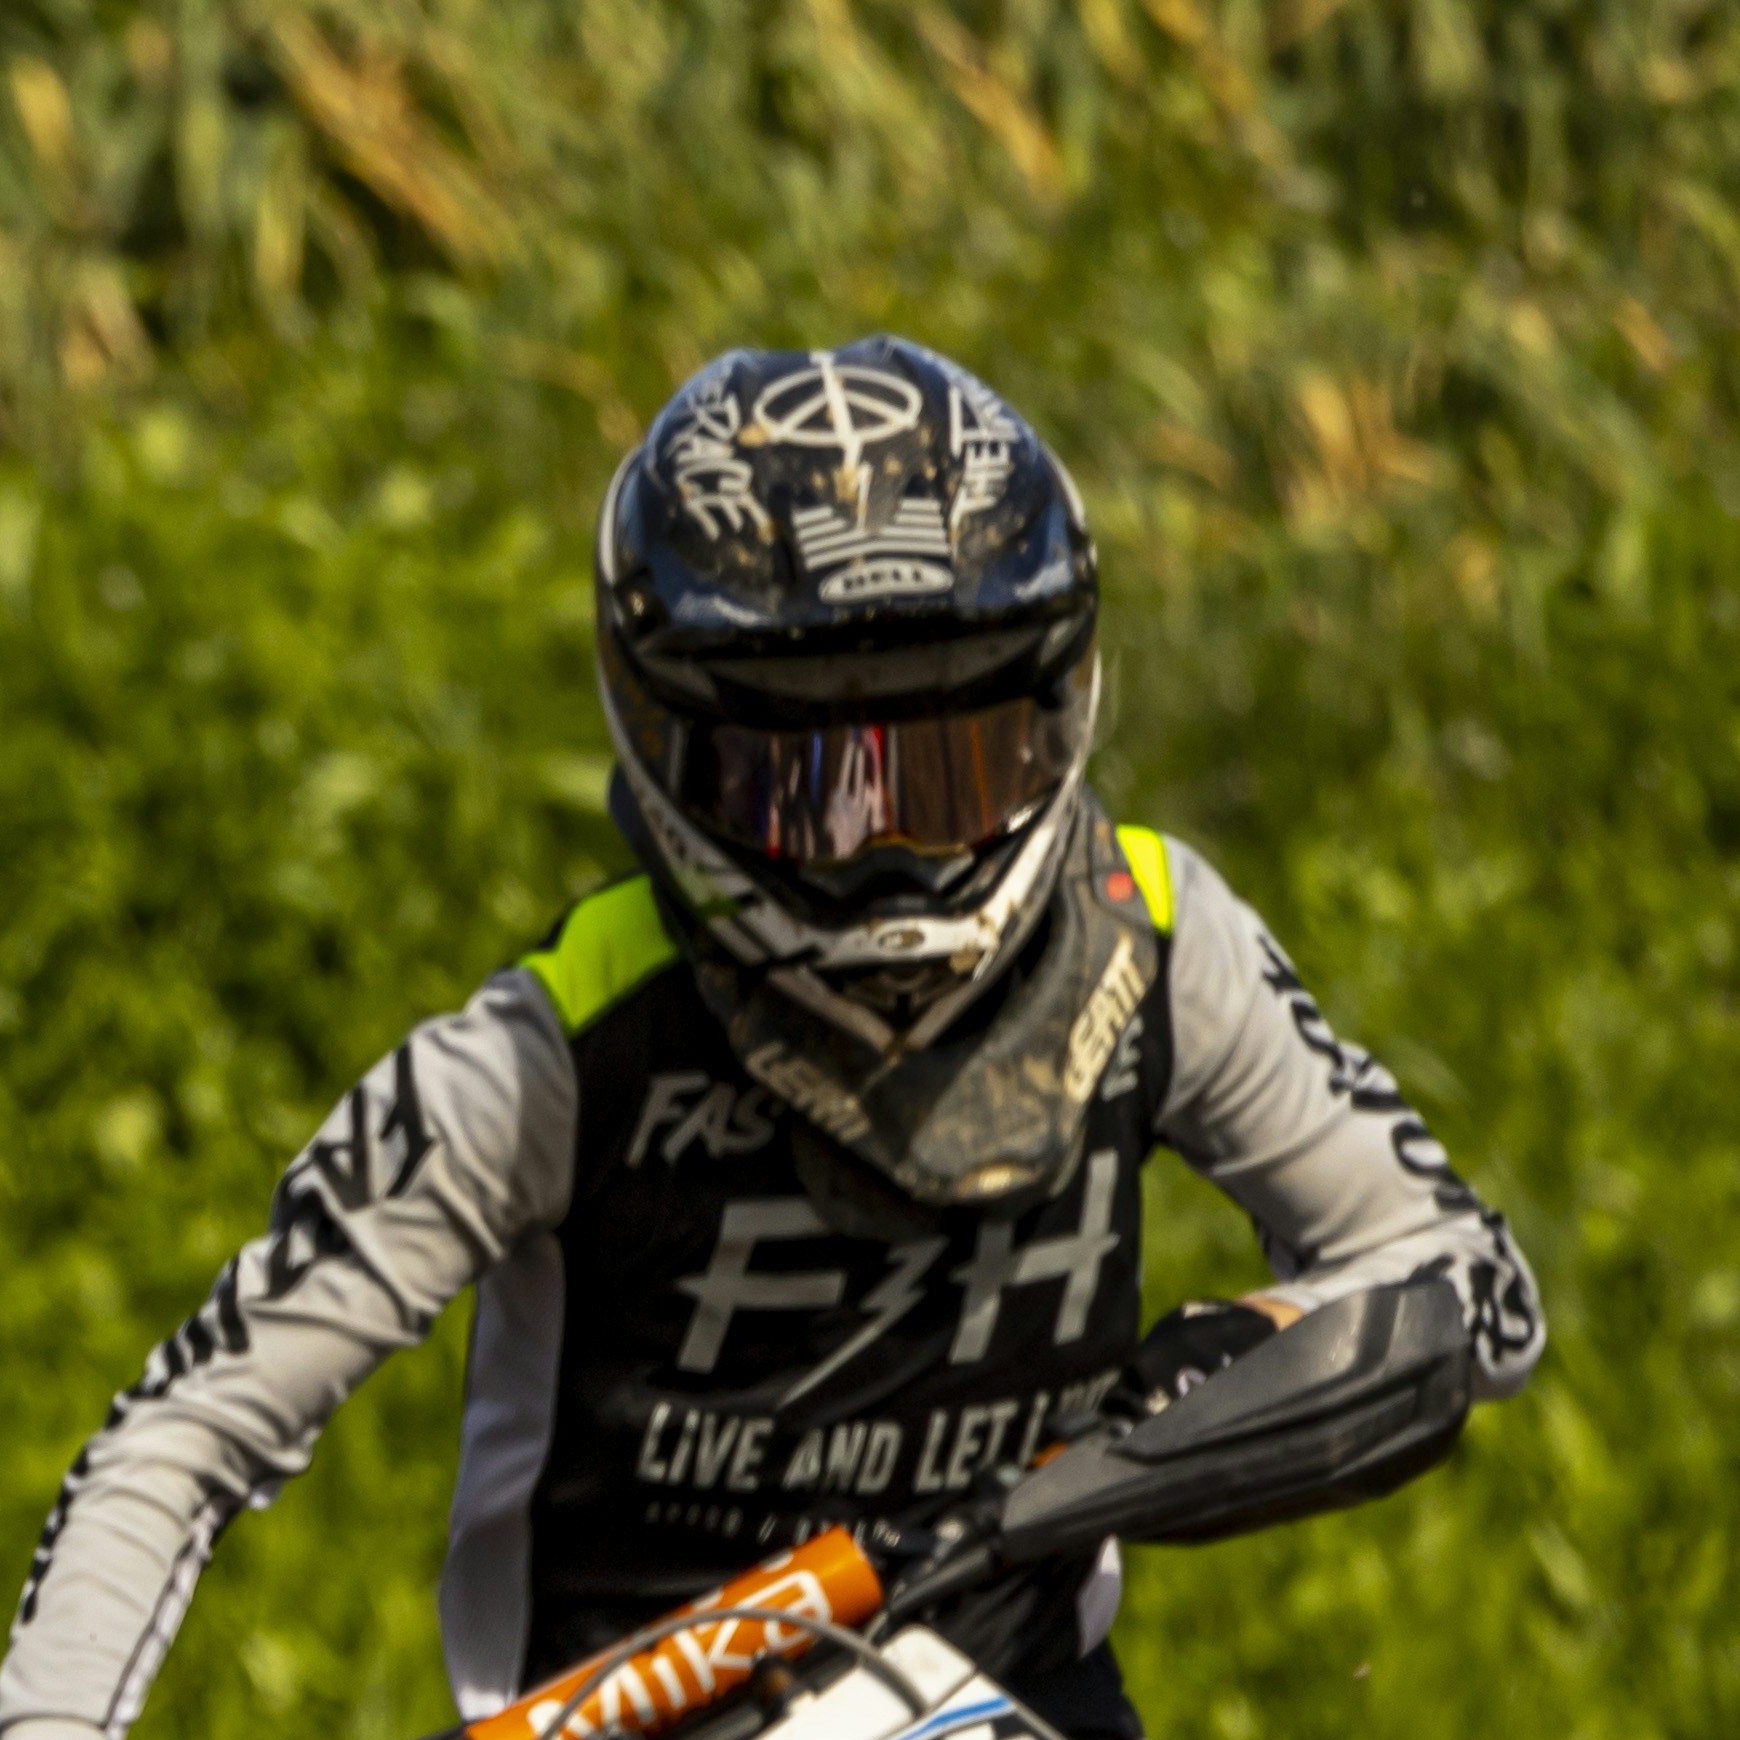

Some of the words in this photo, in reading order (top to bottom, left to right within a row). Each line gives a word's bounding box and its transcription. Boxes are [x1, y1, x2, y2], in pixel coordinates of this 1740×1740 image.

[635, 1399, 774, 1493] LIVE
[781, 1417, 903, 1494] AND
[920, 1399, 1017, 1490] LET
